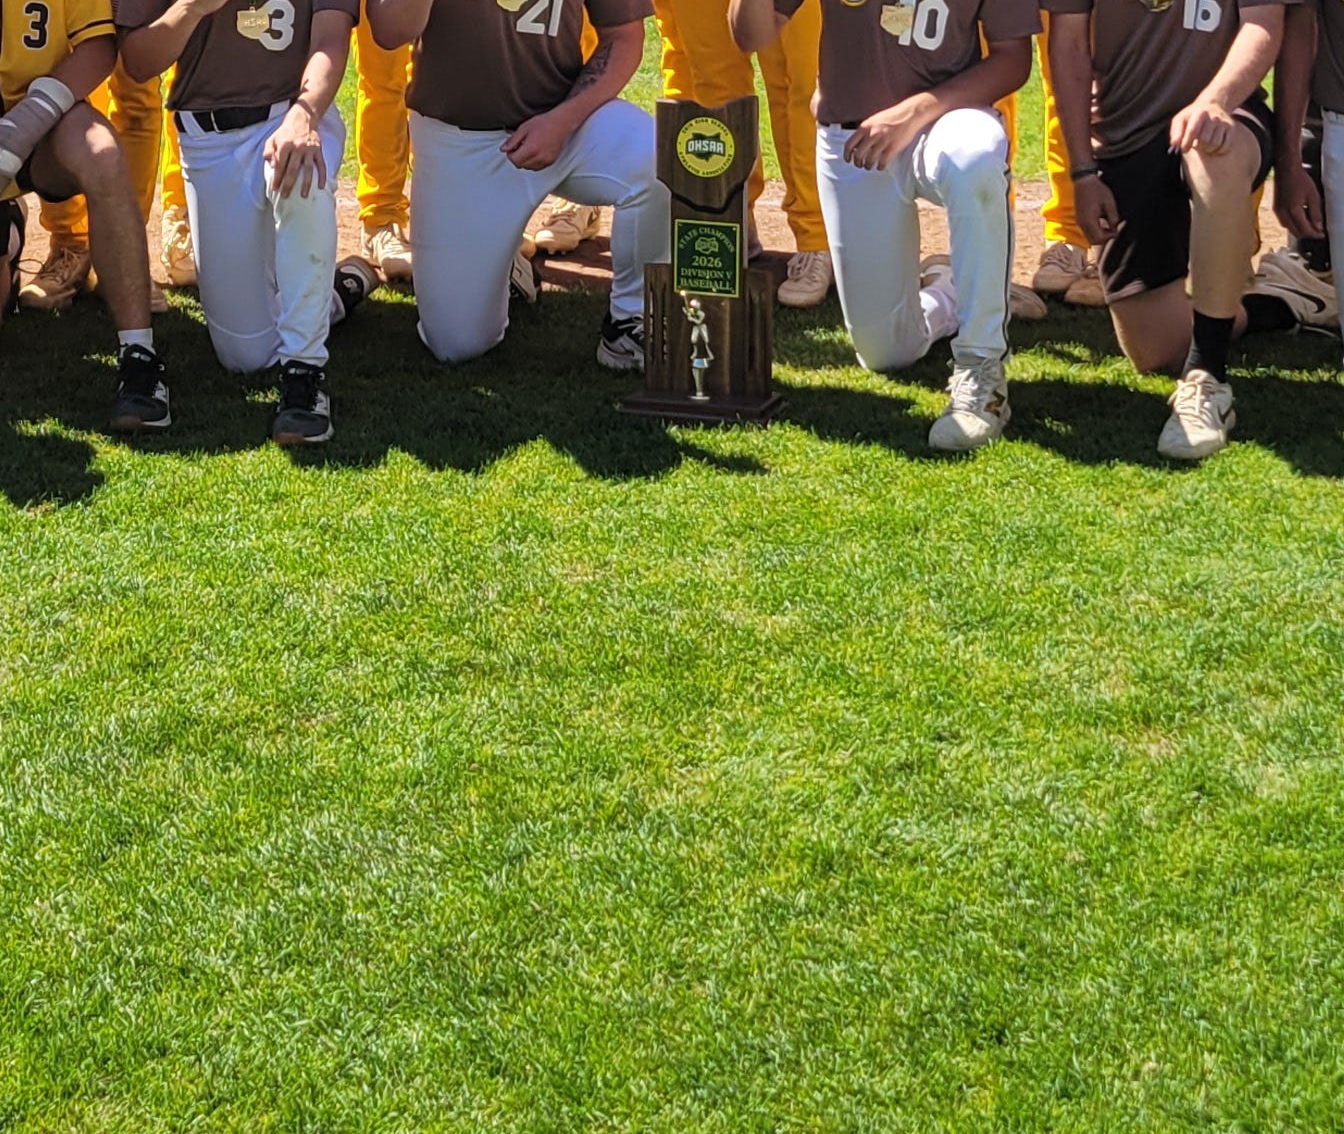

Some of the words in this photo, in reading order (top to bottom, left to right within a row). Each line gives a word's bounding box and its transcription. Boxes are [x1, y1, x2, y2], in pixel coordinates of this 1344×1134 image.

[22, 1, 51, 50] 3
[687, 139, 724, 155] OHSAA
[679, 228, 698, 250] STATE
[691, 255, 722, 268] 2026
[680, 267, 724, 279] DIVISION
[725, 271, 733, 280] V
[680, 277, 733, 291] BASEBALL
